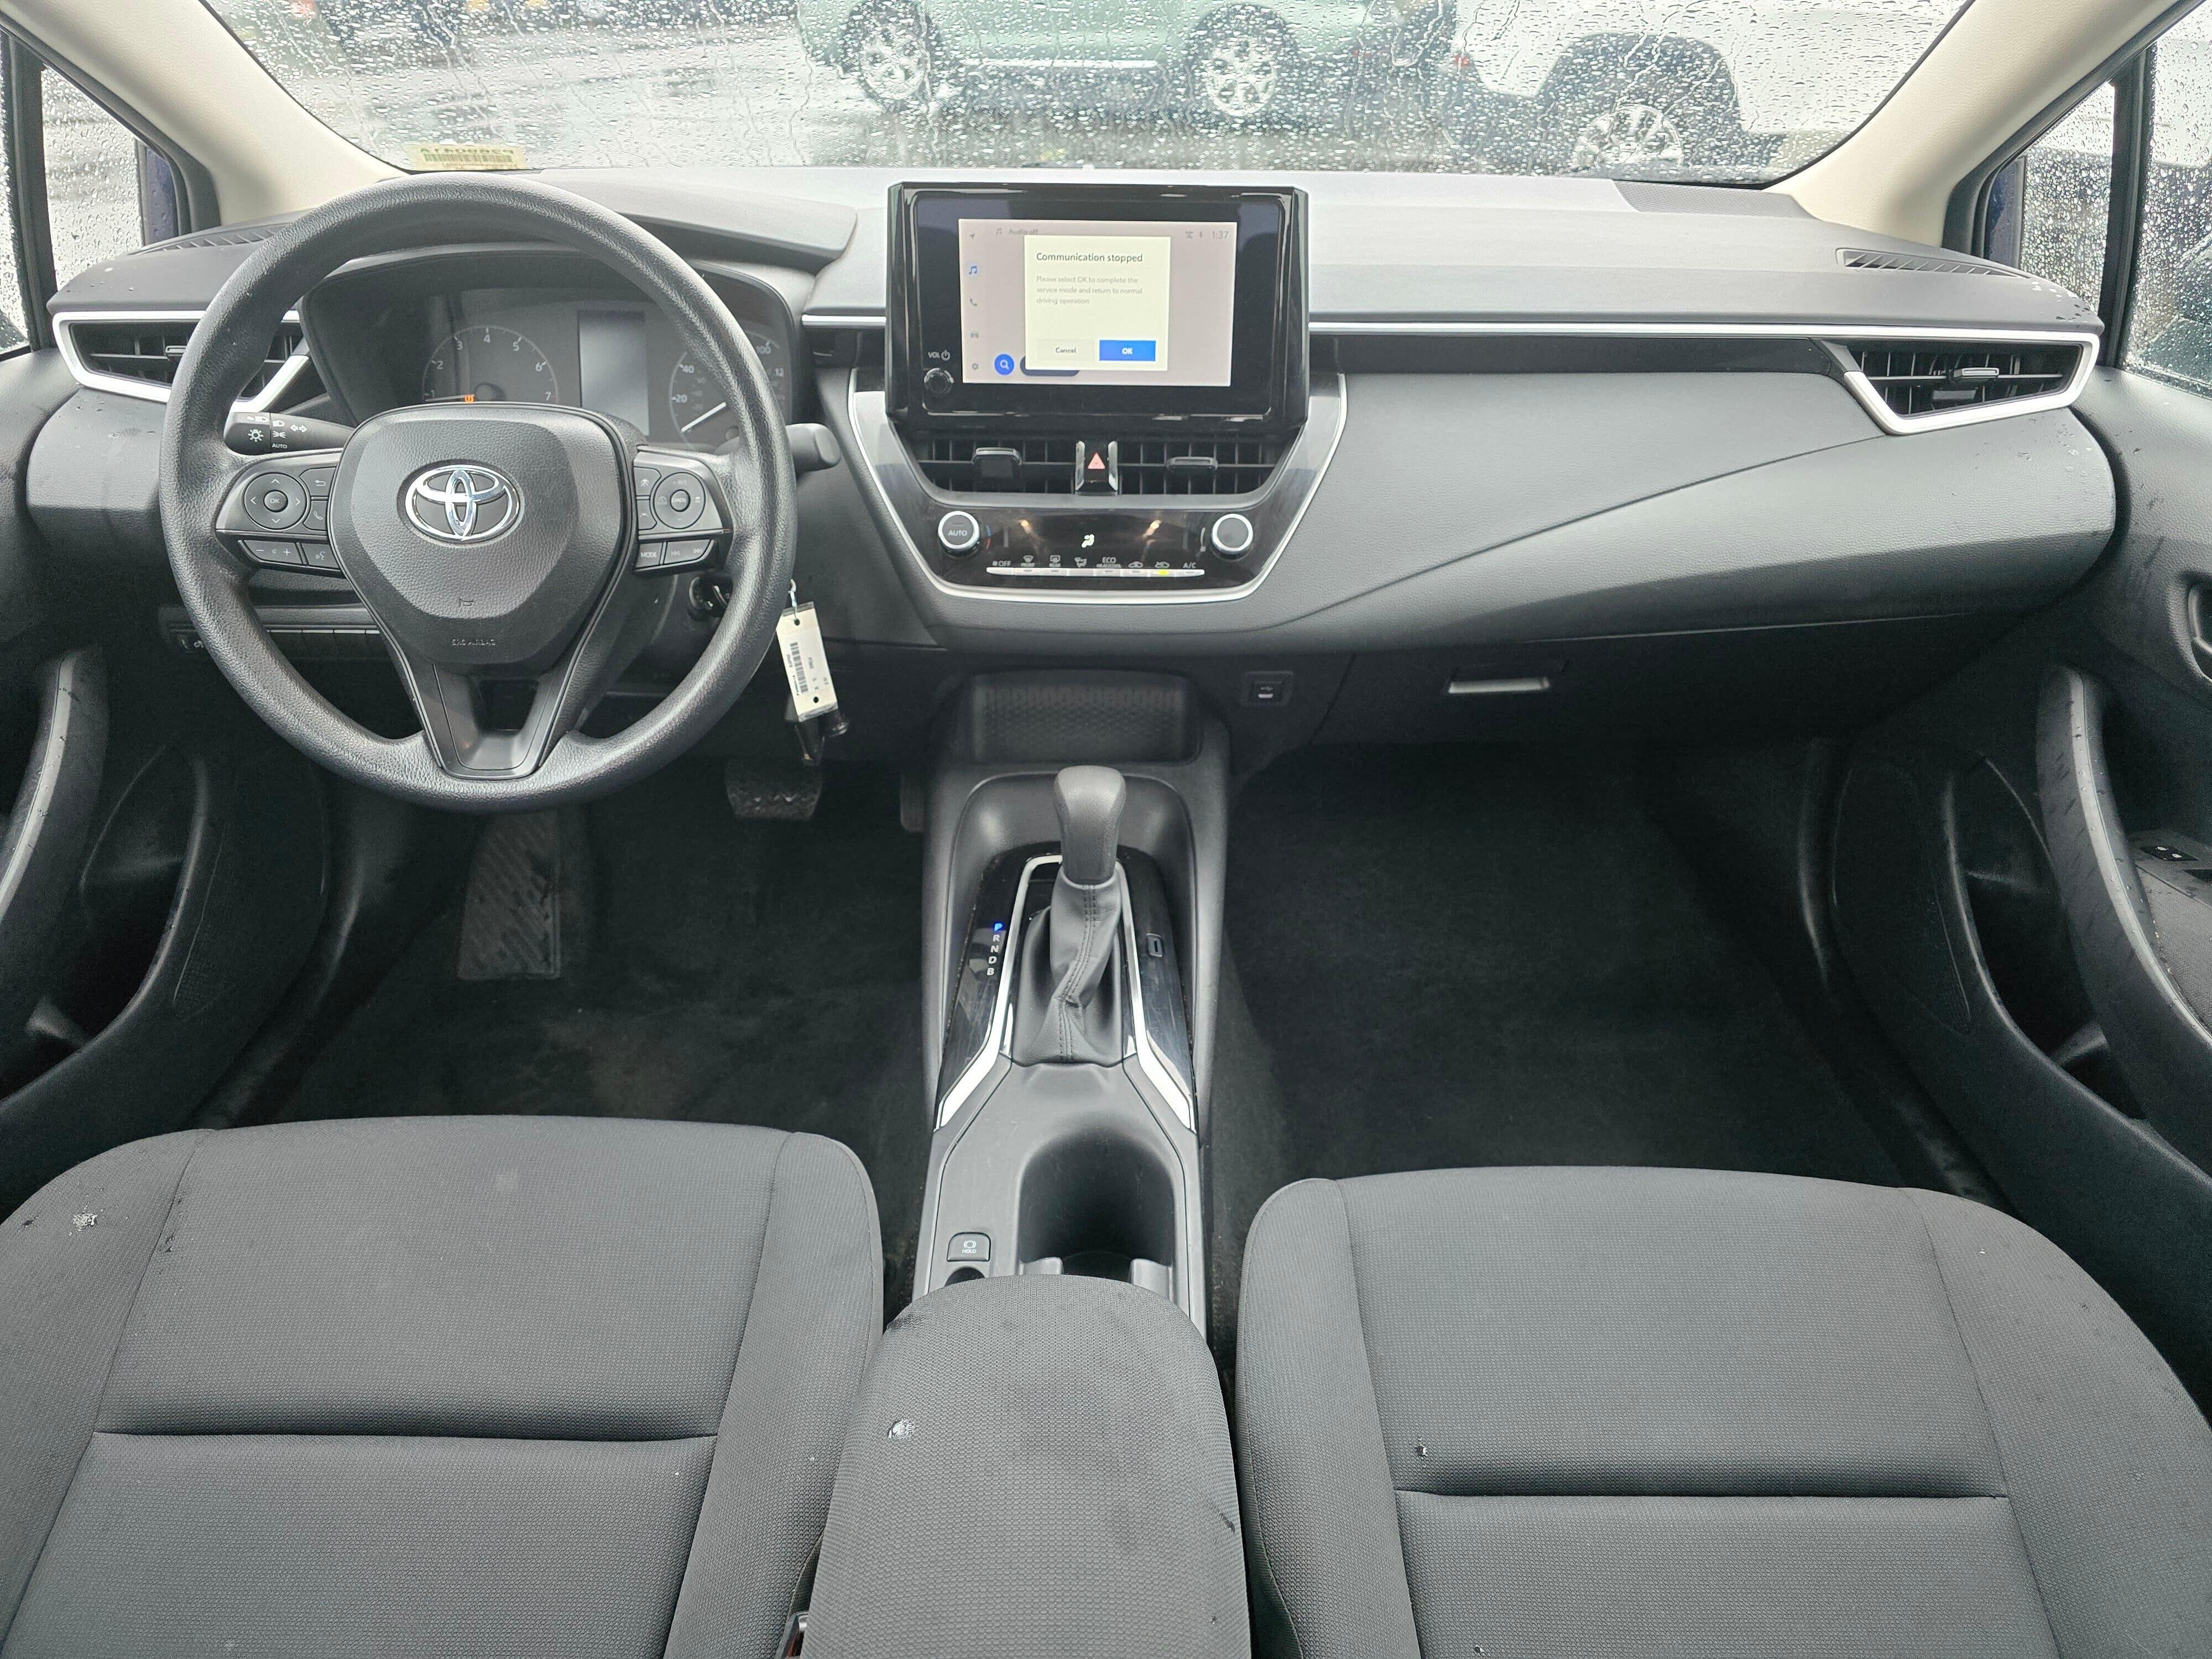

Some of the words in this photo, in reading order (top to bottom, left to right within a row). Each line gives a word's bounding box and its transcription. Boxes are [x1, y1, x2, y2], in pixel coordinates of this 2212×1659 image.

[1213, 230, 1229, 239] 1:37
[1036, 253, 1104, 262] Communication
[1107, 253, 1142, 264] stopped
[483, 334, 491, 343] 4
[457, 341, 463, 350] 3
[513, 342, 520, 351] 5
[436, 361, 444, 369] 2
[535, 362, 542, 372] 6
[682, 365, 695, 373] 40
[545, 392, 551, 401] 7
[676, 394, 687, 403] 20
[994, 923, 1003, 932] P
[990, 945, 999, 953] N
[988, 956, 997, 964] D
[987, 967, 995, 975] B
